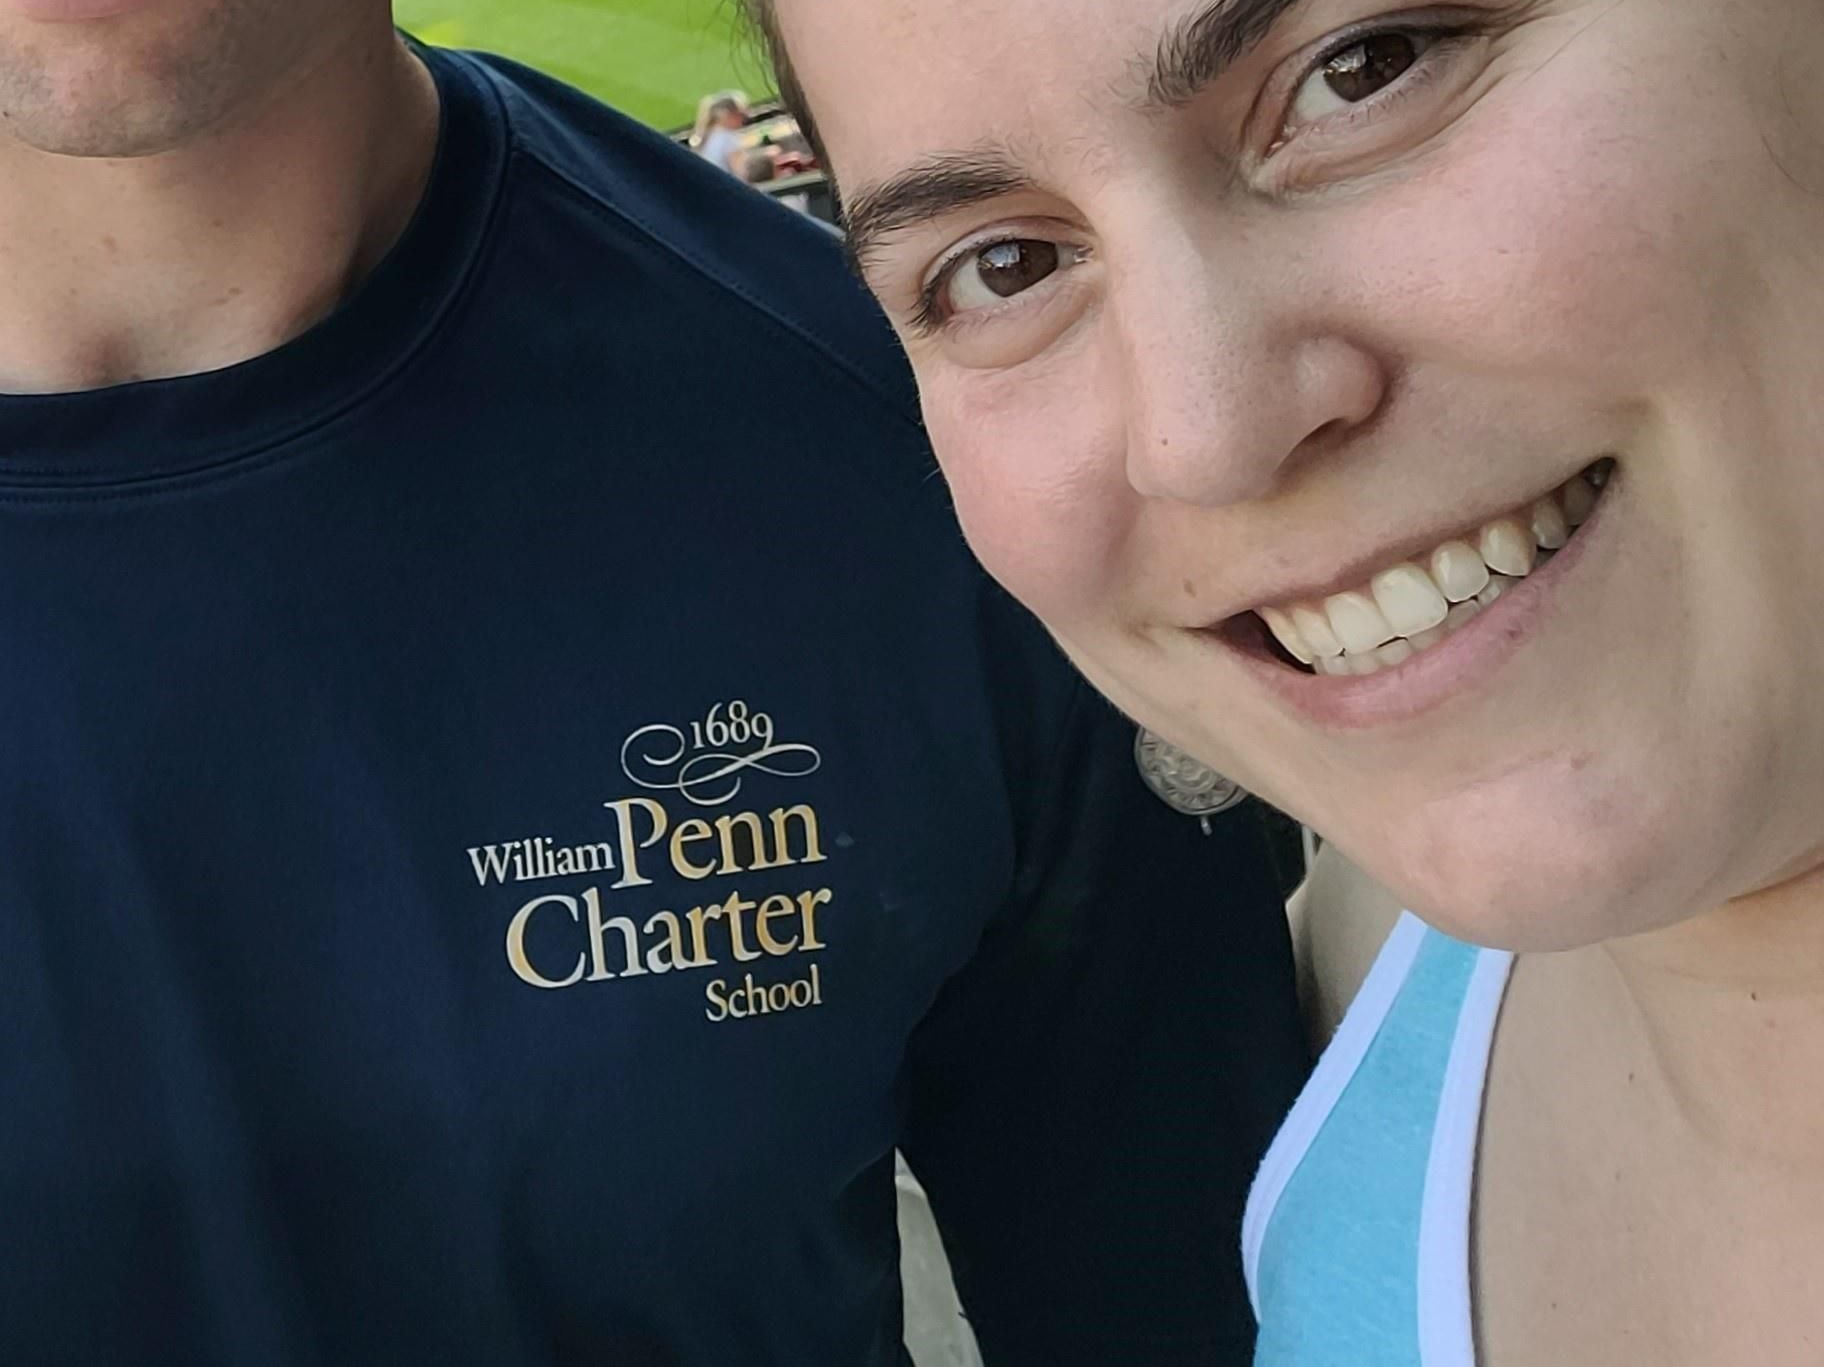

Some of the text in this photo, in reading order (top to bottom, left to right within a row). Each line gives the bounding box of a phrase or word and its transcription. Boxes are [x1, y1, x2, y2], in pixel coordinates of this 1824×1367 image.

[690, 699, 774, 751] 1689
[466, 797, 828, 889] William Penn
[505, 887, 832, 989] Charter
[705, 963, 822, 1022] School
